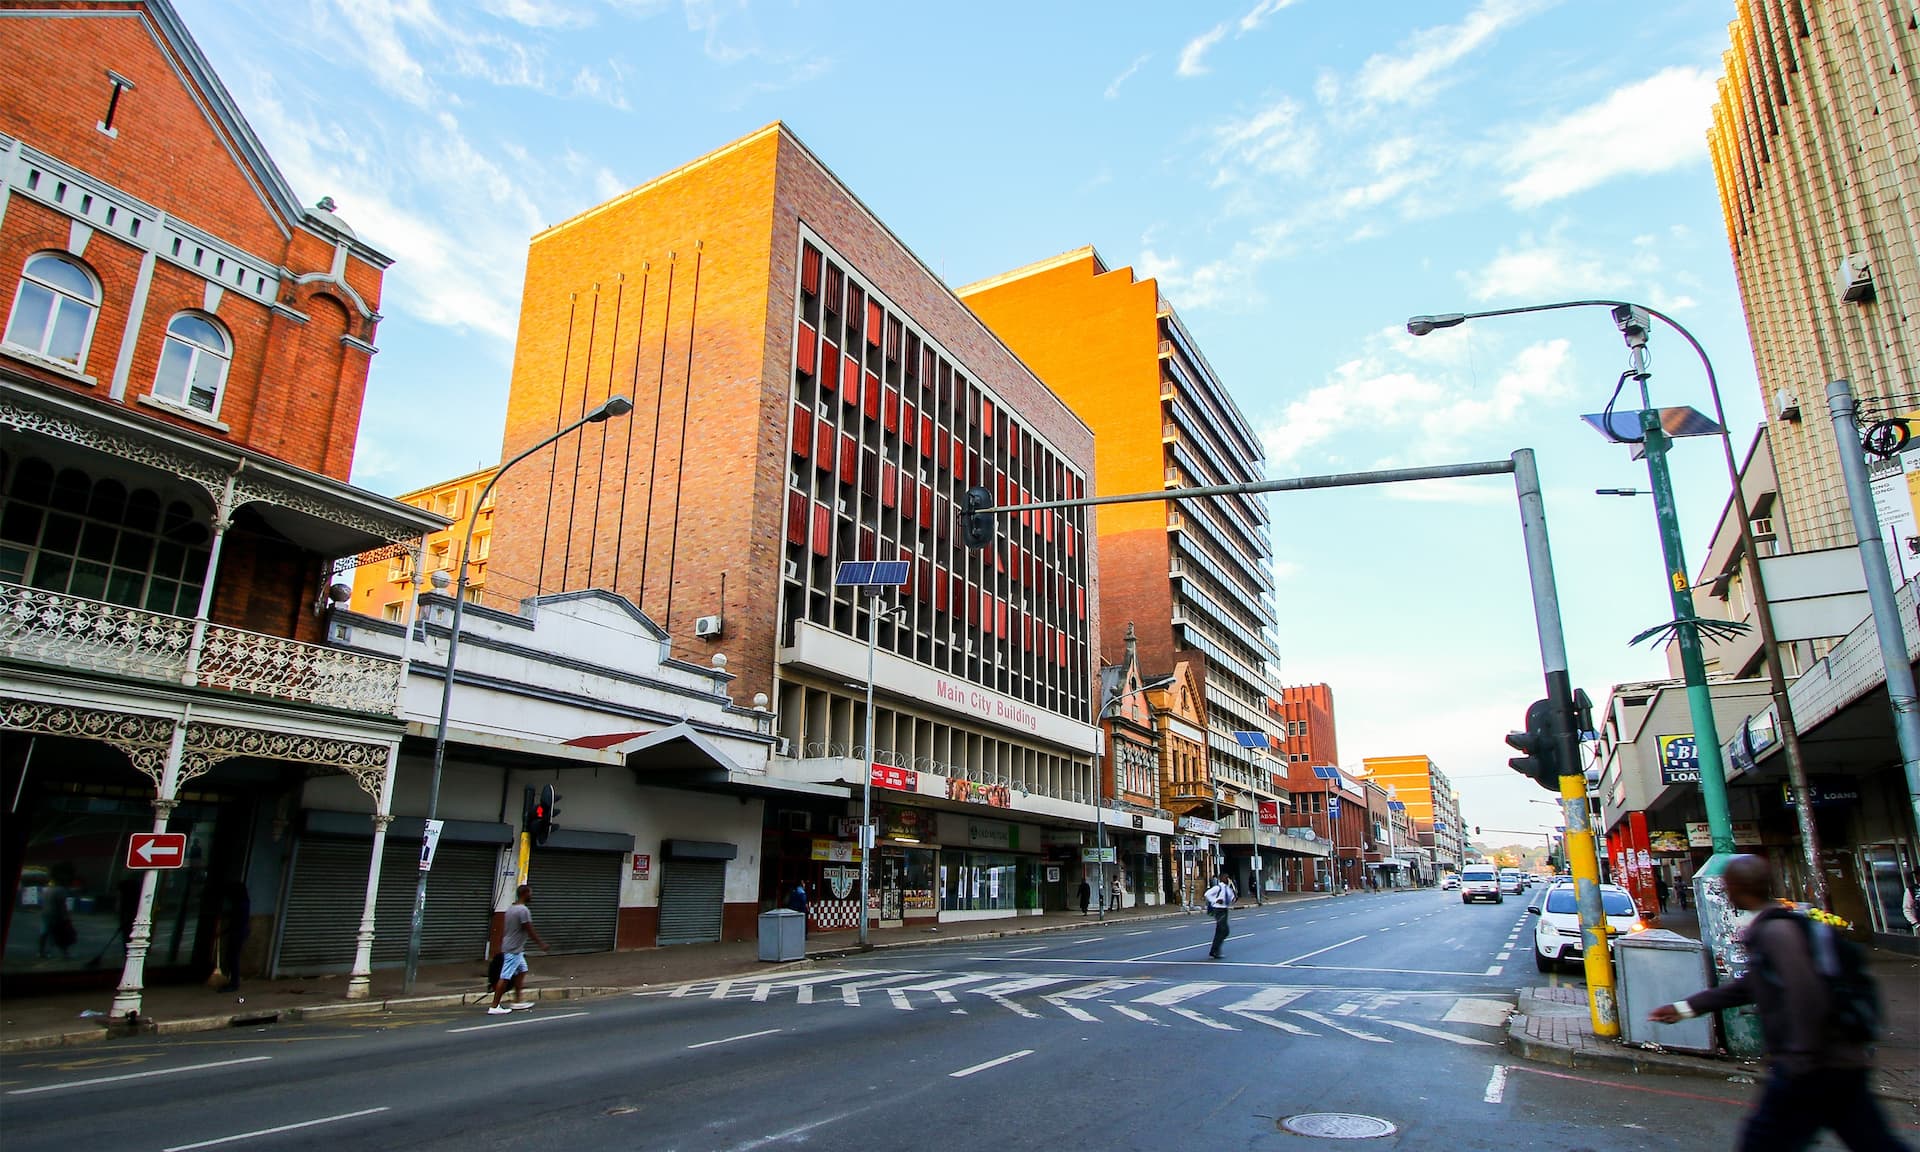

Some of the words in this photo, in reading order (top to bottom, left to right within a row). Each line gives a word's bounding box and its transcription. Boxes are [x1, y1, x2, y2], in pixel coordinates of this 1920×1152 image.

[936, 679, 965, 705] Main
[970, 691, 992, 715] City
[997, 700, 1037, 730] Building
